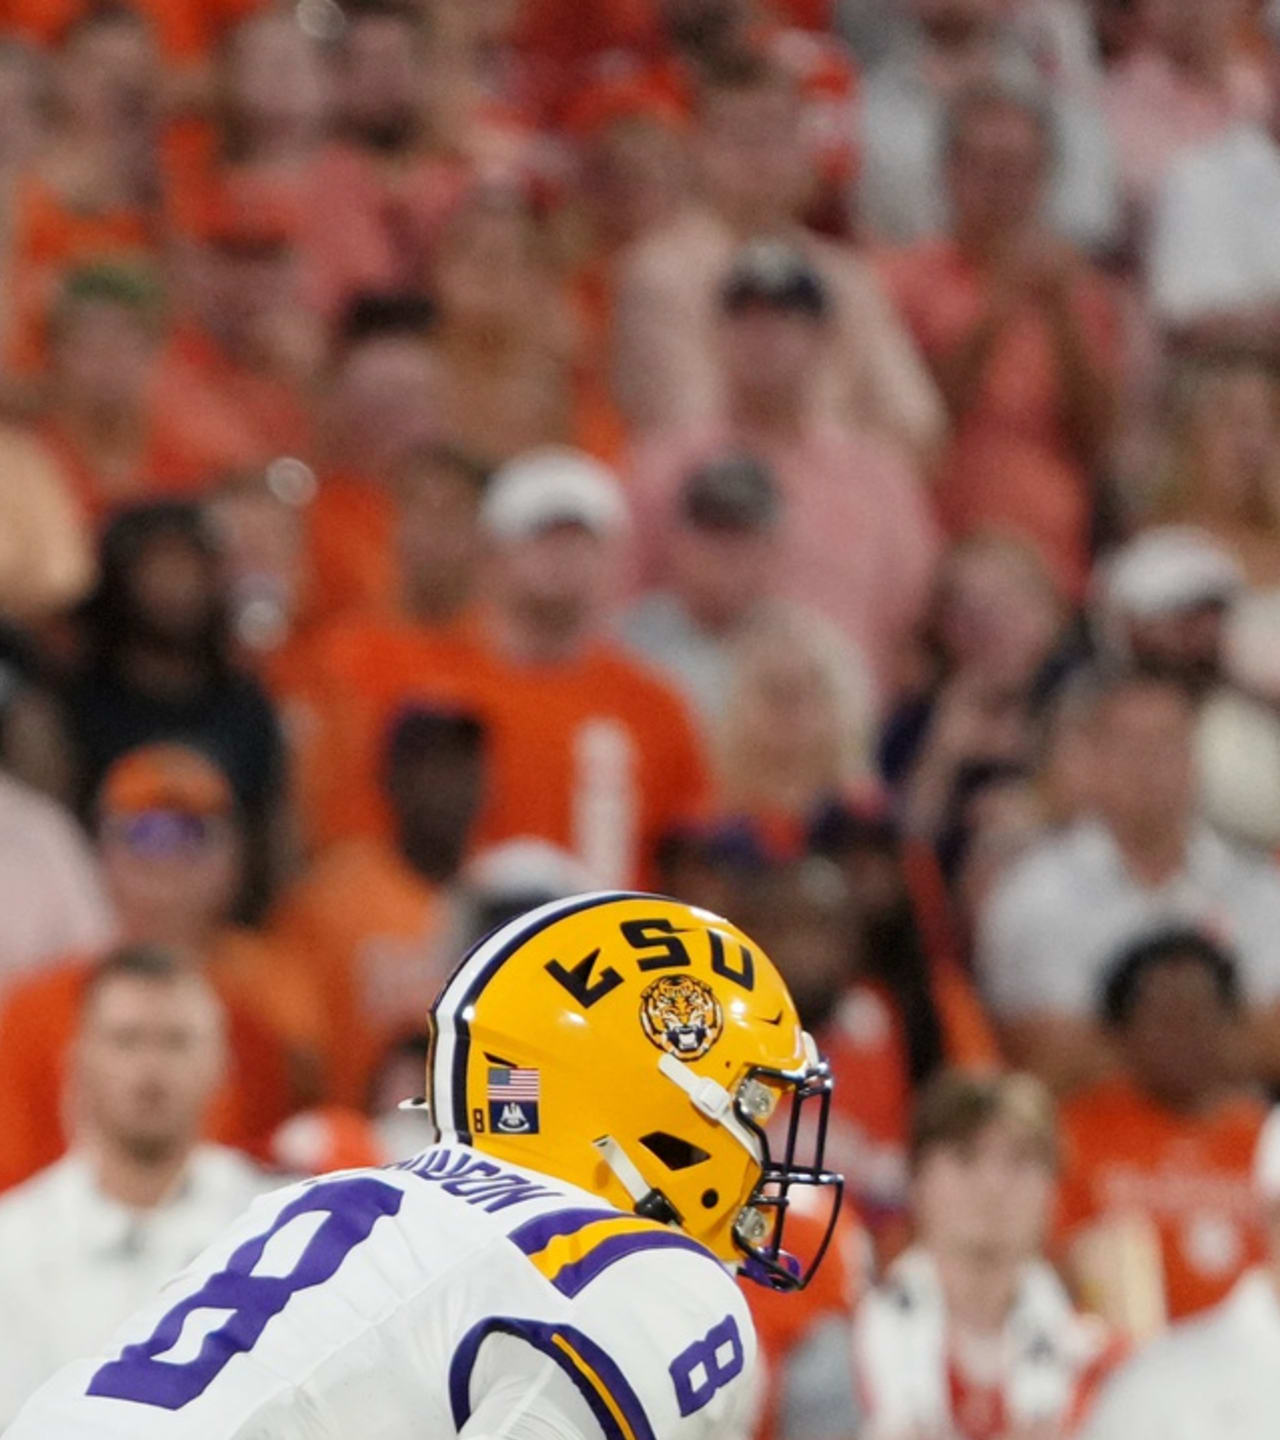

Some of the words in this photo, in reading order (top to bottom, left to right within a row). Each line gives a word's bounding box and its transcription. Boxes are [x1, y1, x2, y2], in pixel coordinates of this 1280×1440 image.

[544, 918, 755, 1008] LSU
[85, 1177, 404, 1411] 8
[668, 1314, 744, 1418] 8
